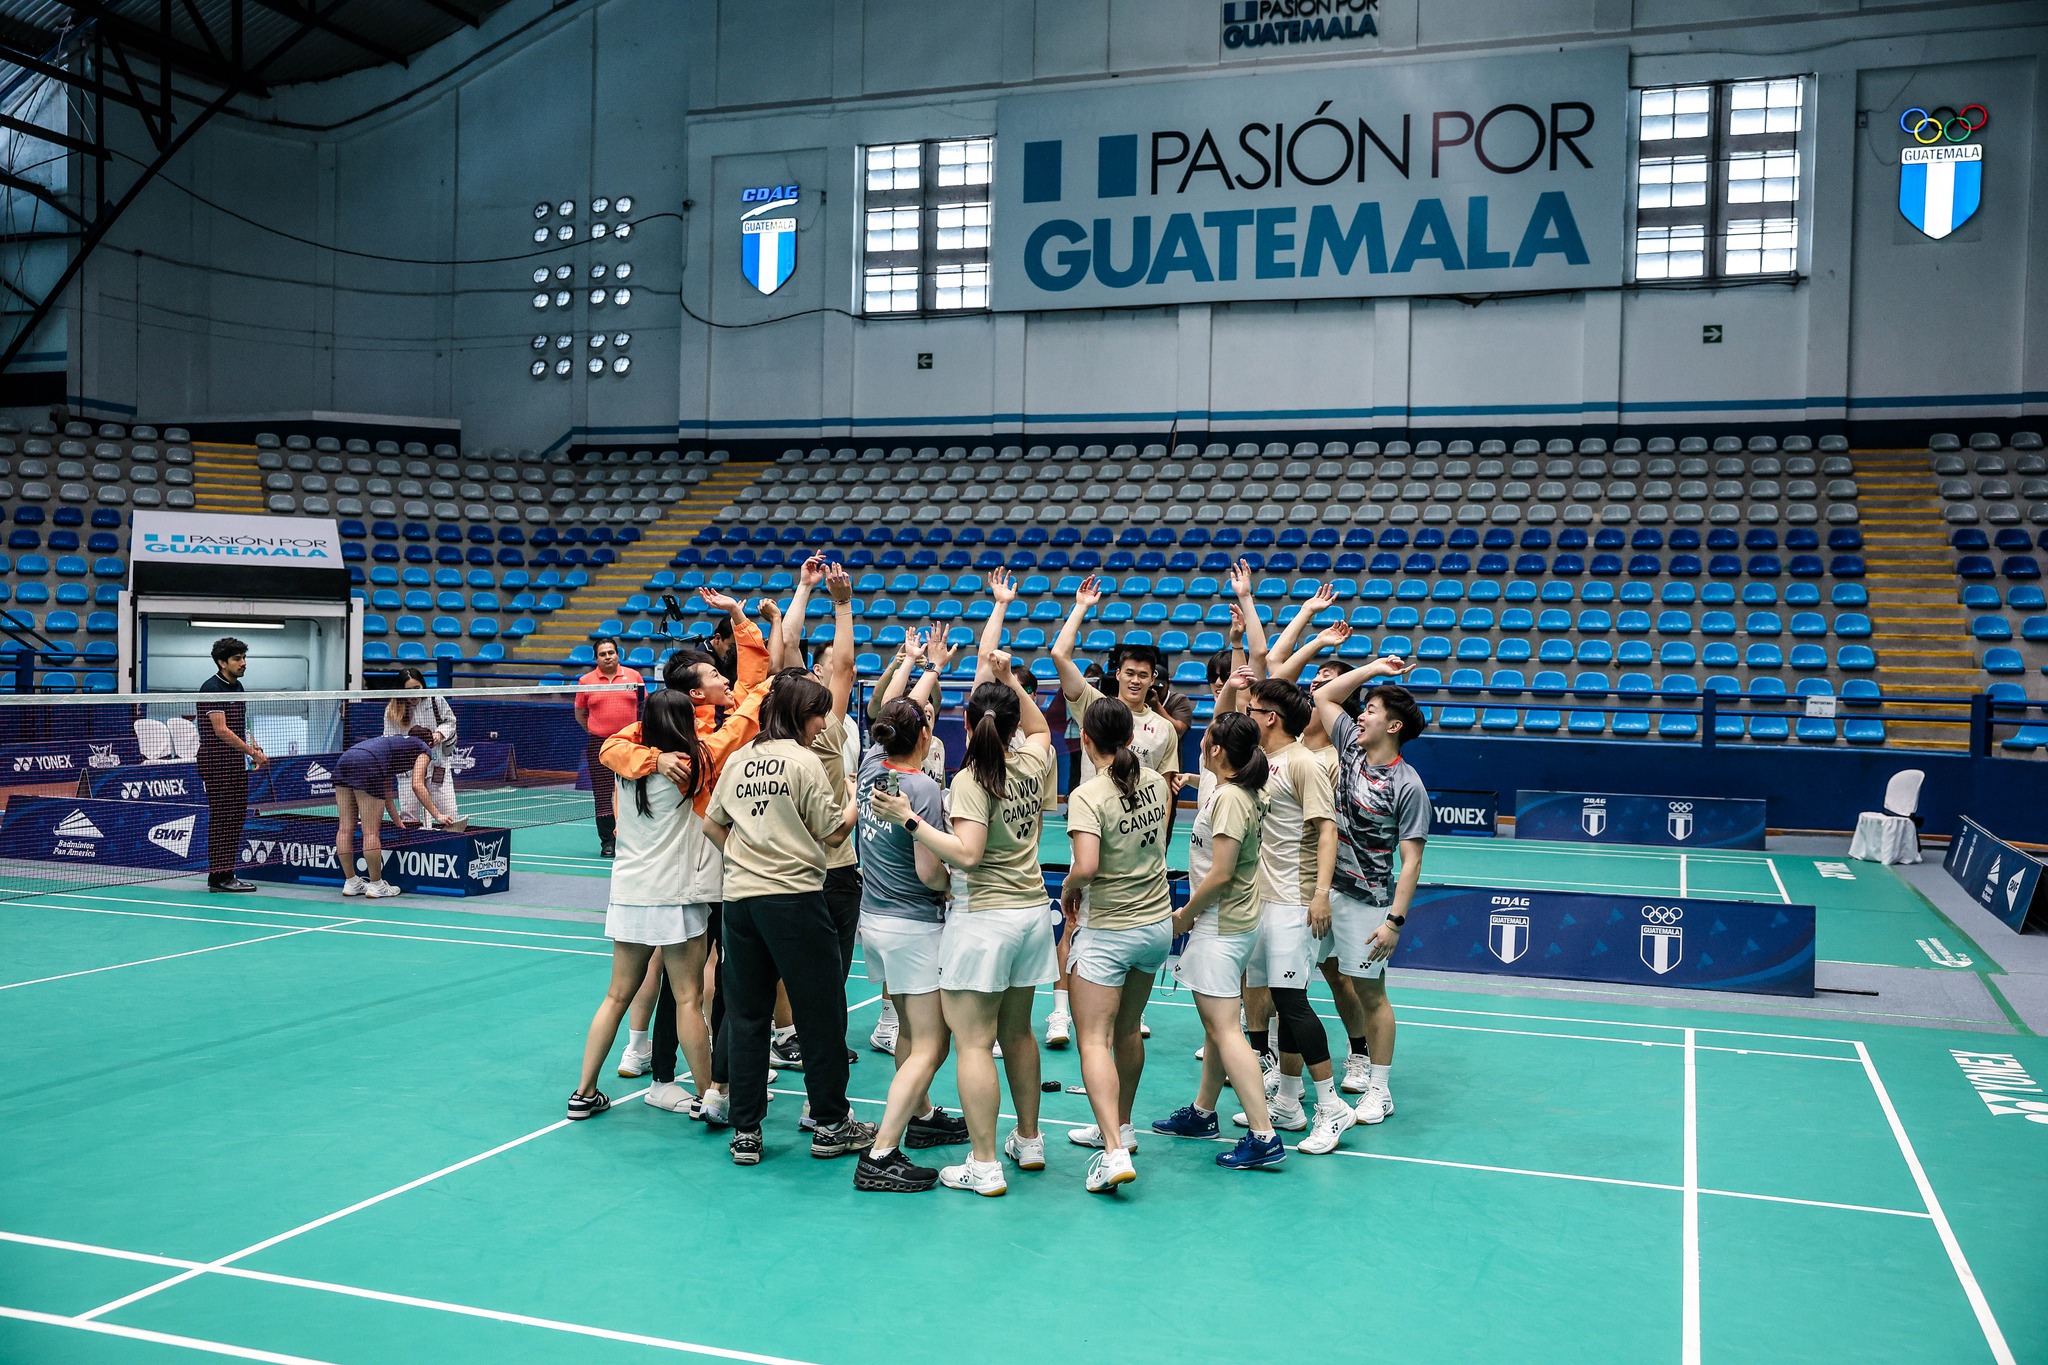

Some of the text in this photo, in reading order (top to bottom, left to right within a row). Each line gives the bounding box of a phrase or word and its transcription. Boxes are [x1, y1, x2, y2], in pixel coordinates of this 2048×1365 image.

[1223, 14, 1378, 49] GUATEMALA
[1151, 100, 1594, 195] PASIÓN POR
[1904, 147, 1980, 161] GUATEMALA
[742, 185, 798, 203] CDAG
[744, 220, 794, 232] GUATEMALA
[1024, 191, 1590, 291] GUATEMALA
[190, 535, 327, 548] PASIÓN POR
[145, 543, 328, 558] GUATEMALA
[35, 755, 73, 770] YONEX
[744, 759, 786, 778] CHOI
[144, 779, 187, 797] YONEX
[736, 781, 790, 799] CANADA
[1119, 804, 1166, 834] CANADA
[1433, 806, 1487, 825] YONEX
[153, 829, 189, 841] BWF
[53, 847, 96, 857] Pan America
[57, 840, 95, 849] Badminton
[279, 842, 338, 869] YONEX
[396, 851, 459, 879] YONEX
[470, 860, 506, 871] BADMINTON
[1491, 896, 1530, 907] CDAG
[1492, 917, 1527, 925] GUATEMALA
[1643, 926, 1680, 936] GUATEMALA
[1948, 1049, 2044, 1093] YONEX
